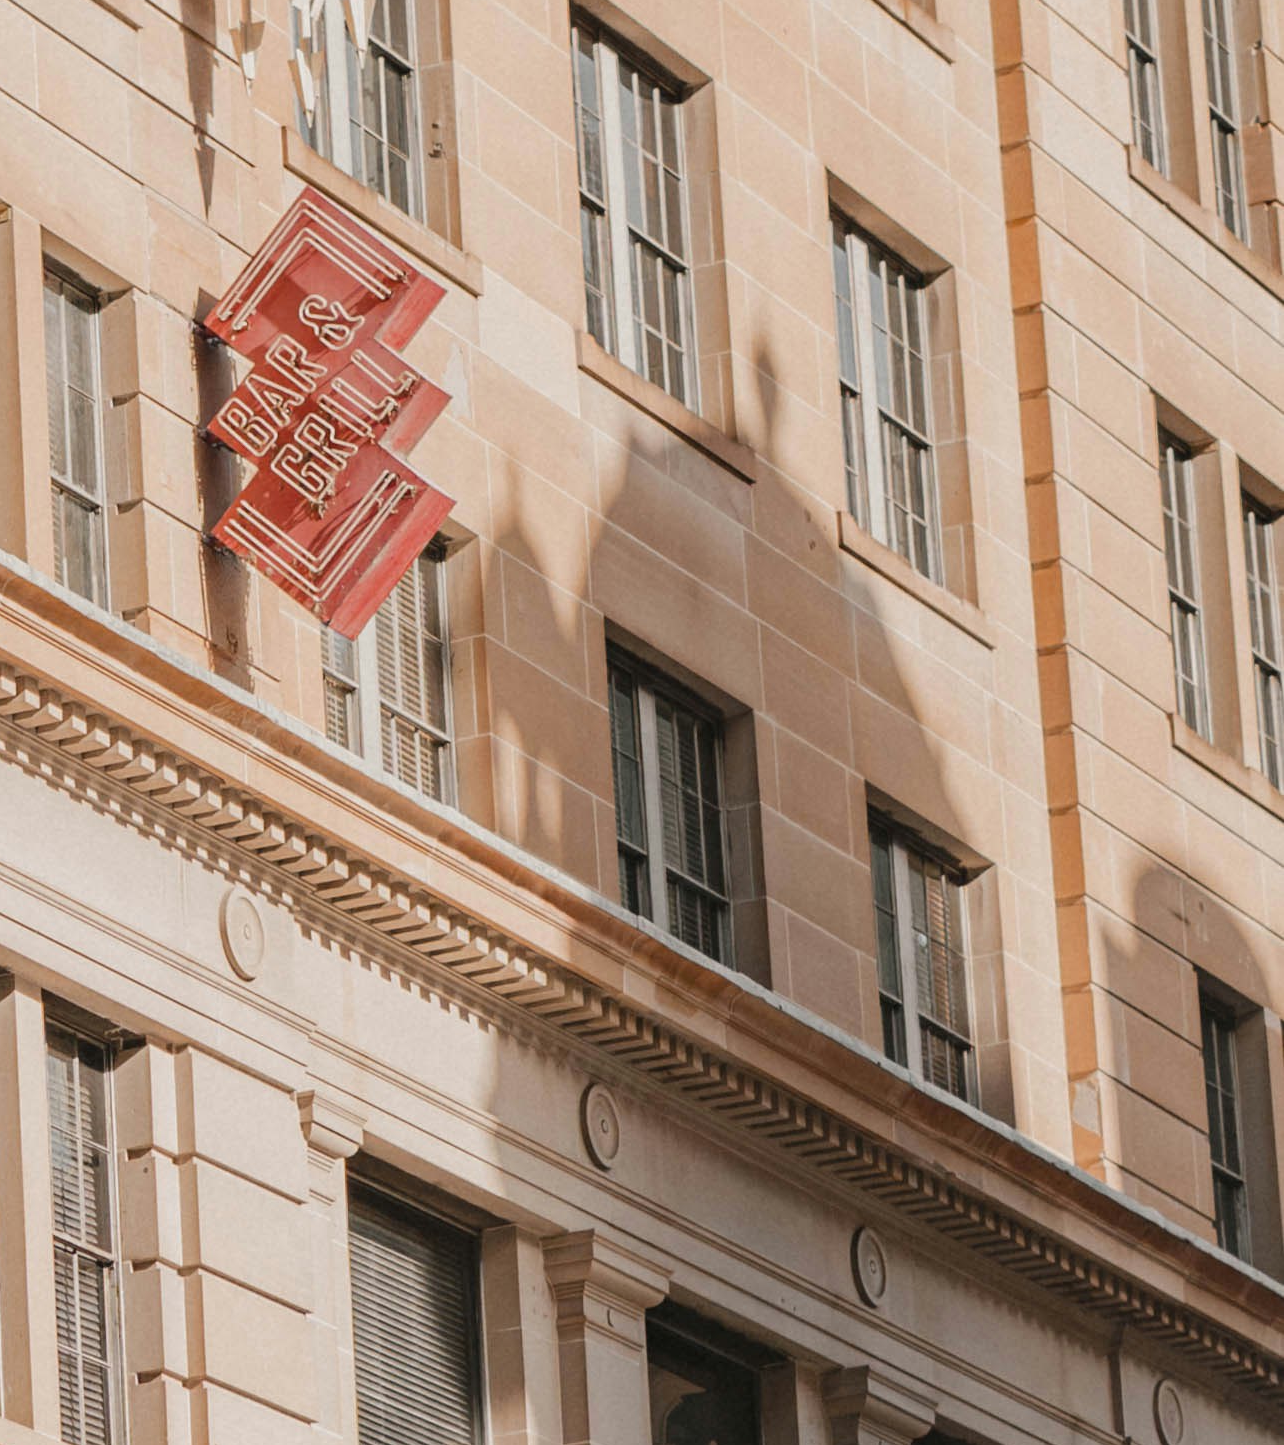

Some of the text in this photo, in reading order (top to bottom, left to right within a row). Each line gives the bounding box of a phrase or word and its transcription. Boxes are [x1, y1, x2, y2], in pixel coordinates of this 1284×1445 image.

[217, 293, 365, 458] BAR &
[270, 348, 419, 505] GRILL
